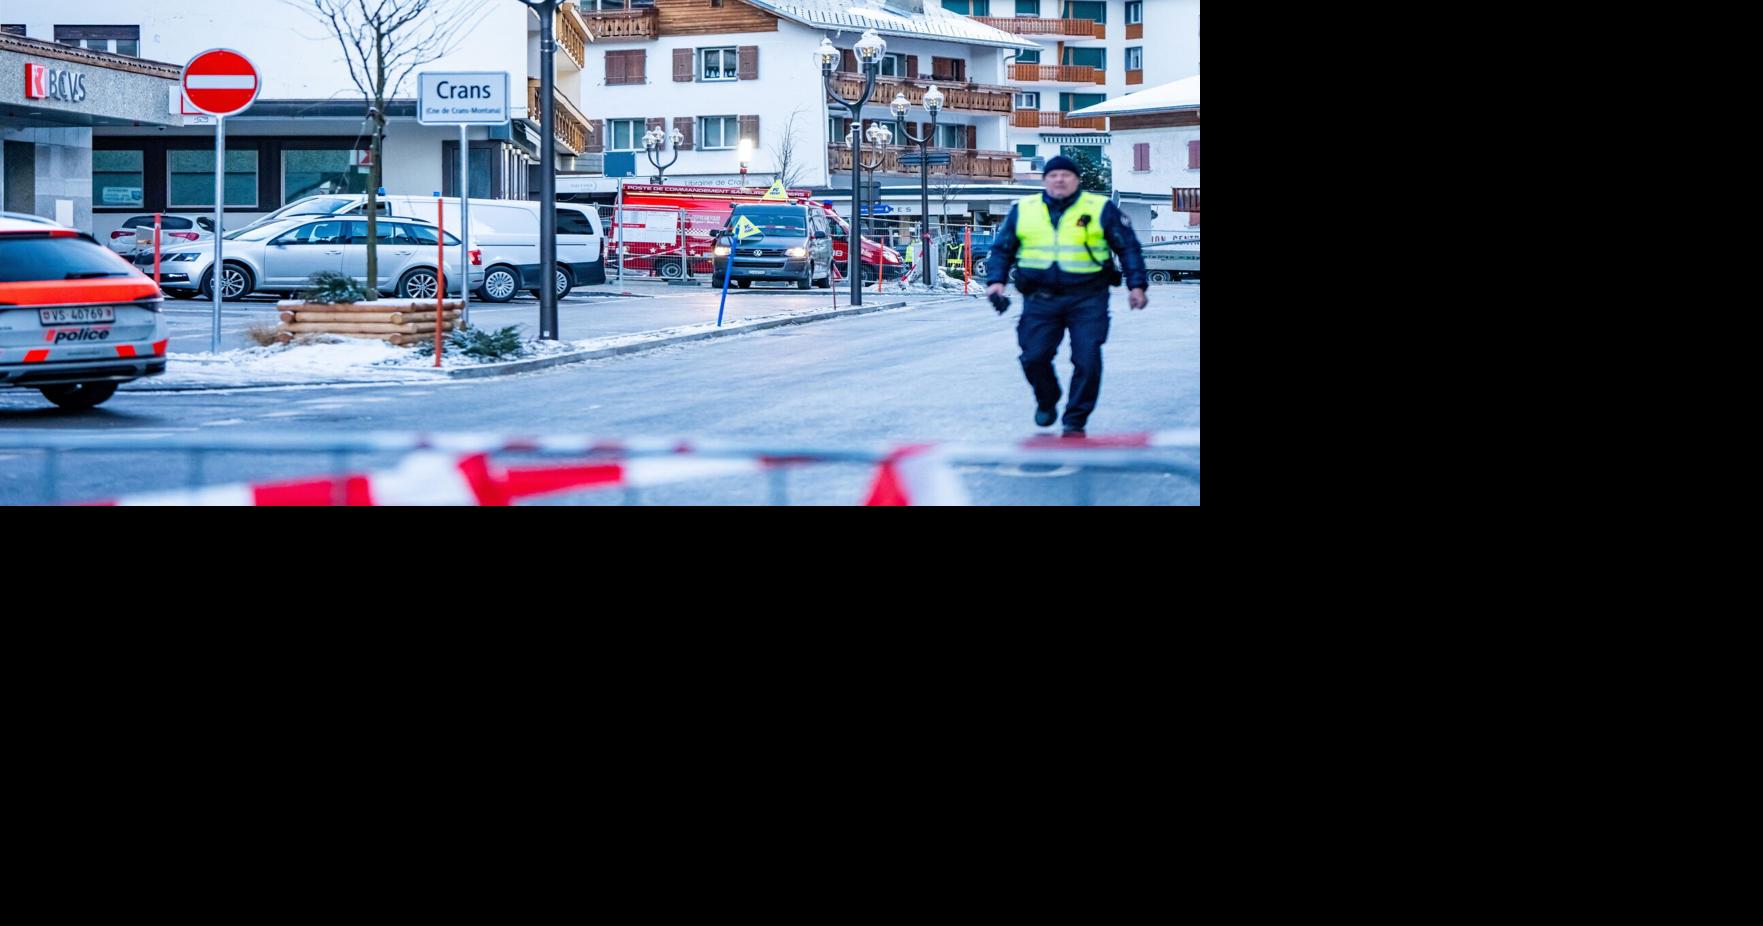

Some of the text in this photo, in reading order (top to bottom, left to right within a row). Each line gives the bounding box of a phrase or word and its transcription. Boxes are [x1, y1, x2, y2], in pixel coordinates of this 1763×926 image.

[49, 69, 86, 102] BCVS
[436, 80, 491, 99] Crans
[54, 328, 109, 345] police
